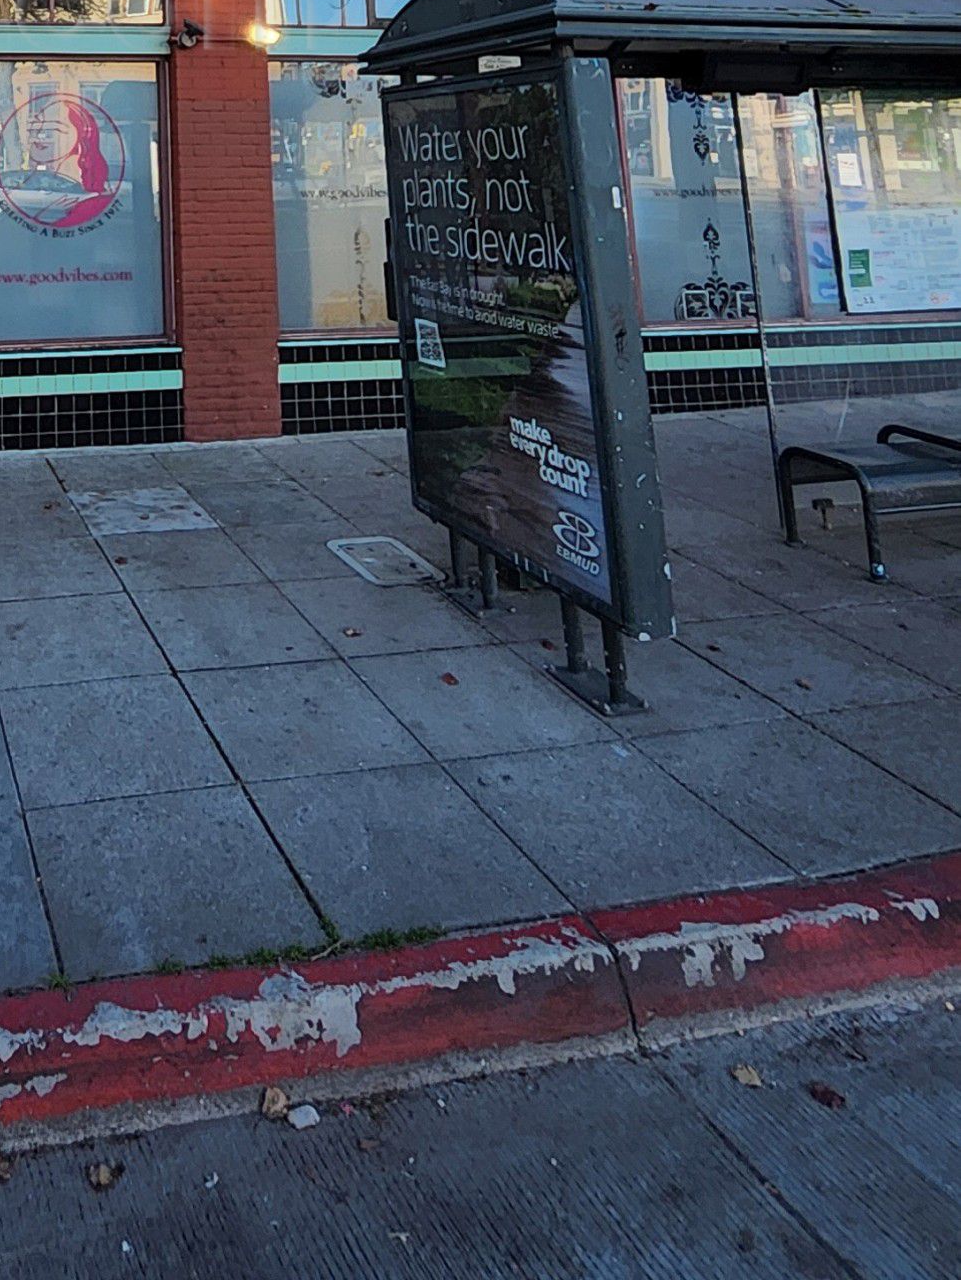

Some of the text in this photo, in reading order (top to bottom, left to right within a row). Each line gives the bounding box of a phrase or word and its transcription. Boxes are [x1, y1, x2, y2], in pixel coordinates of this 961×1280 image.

[398, 123, 528, 169] Water your
[403, 168, 533, 218] plants, not
[39, 228, 48, 237] A
[103, 199, 124, 220] 1977
[405, 214, 571, 272] the sidewalk
[498, 314, 525, 331] water
[509, 416, 552, 446] make
[509, 432, 591, 479] every drop
[540, 465, 588, 498] count
[556, 544, 600, 577] EBMUD
